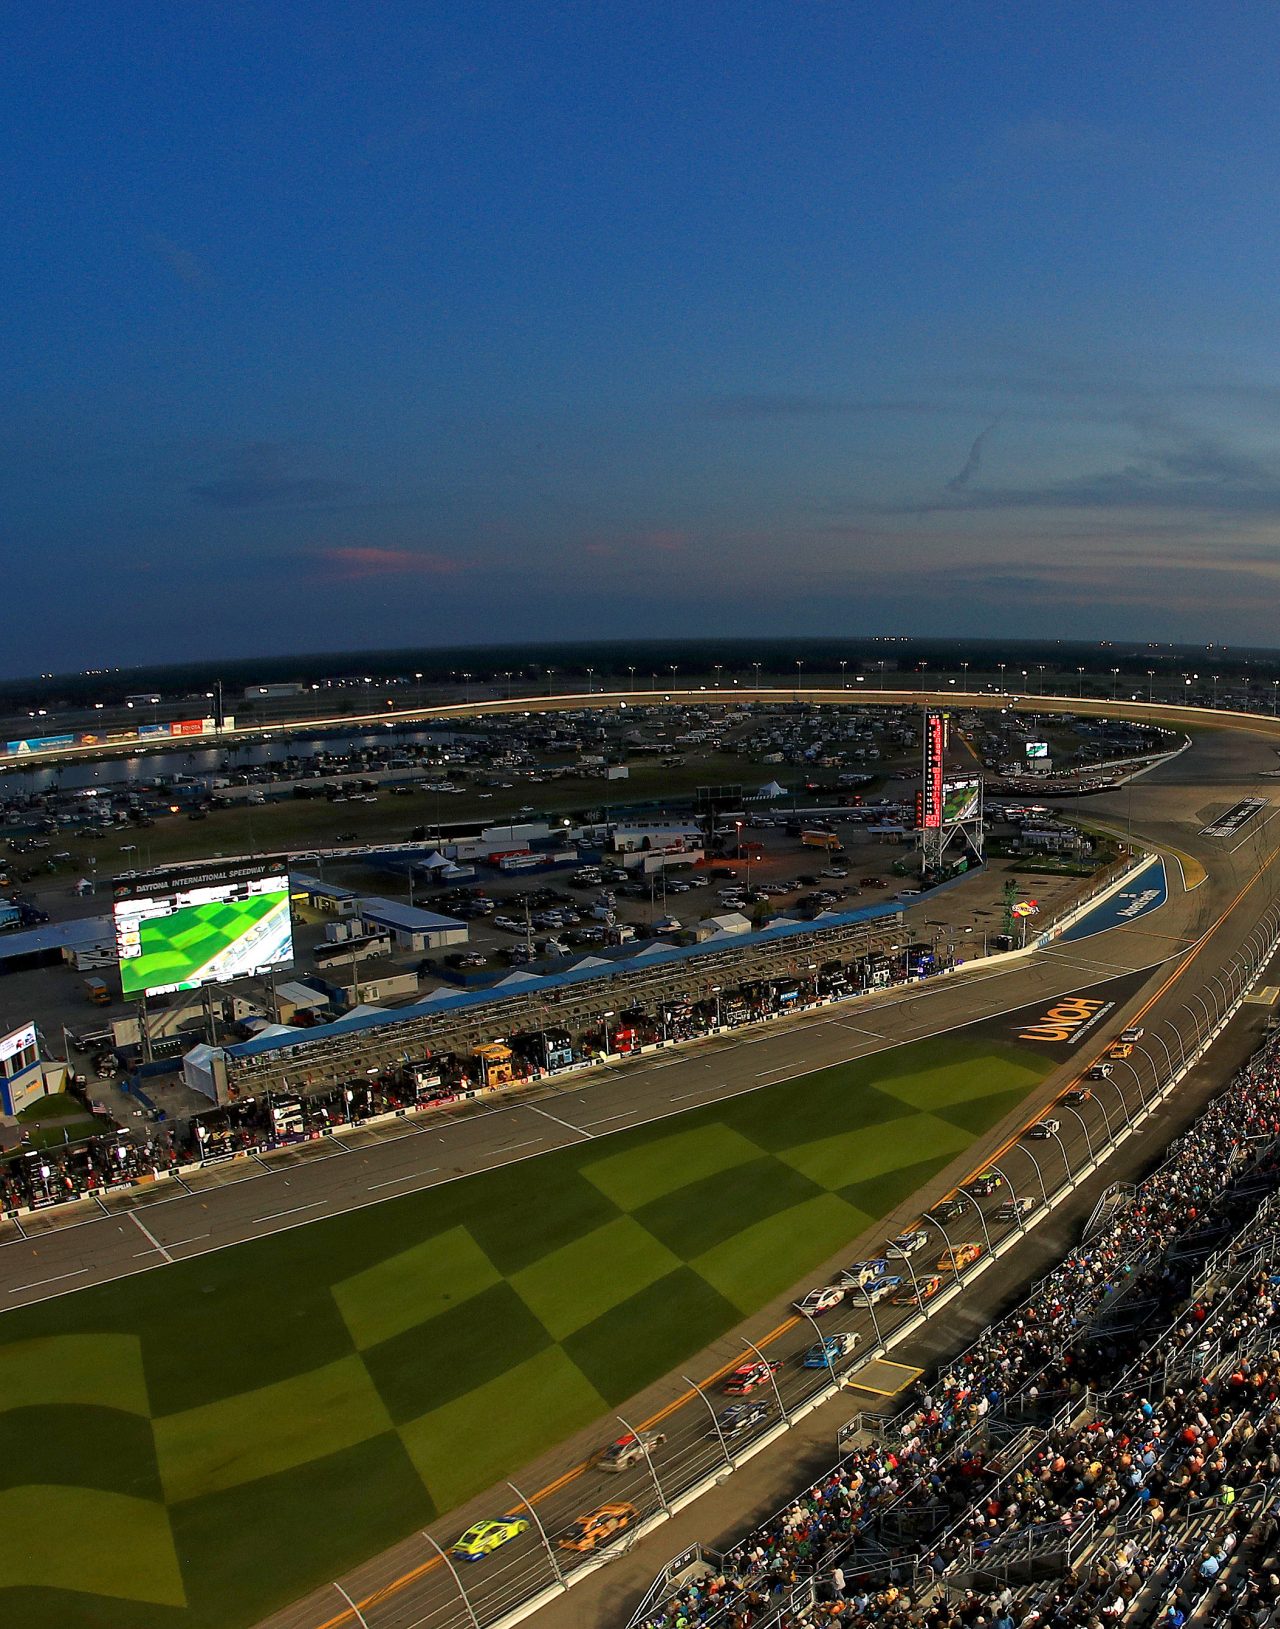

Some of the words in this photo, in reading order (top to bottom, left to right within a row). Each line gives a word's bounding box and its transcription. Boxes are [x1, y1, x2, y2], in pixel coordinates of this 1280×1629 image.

[136, 881, 169, 893] DAYTONA
[171, 873, 228, 887] INTERNATIONAL
[229, 865, 266, 878] SPEEDWAY
[1016, 997, 1105, 1042] UNOH
